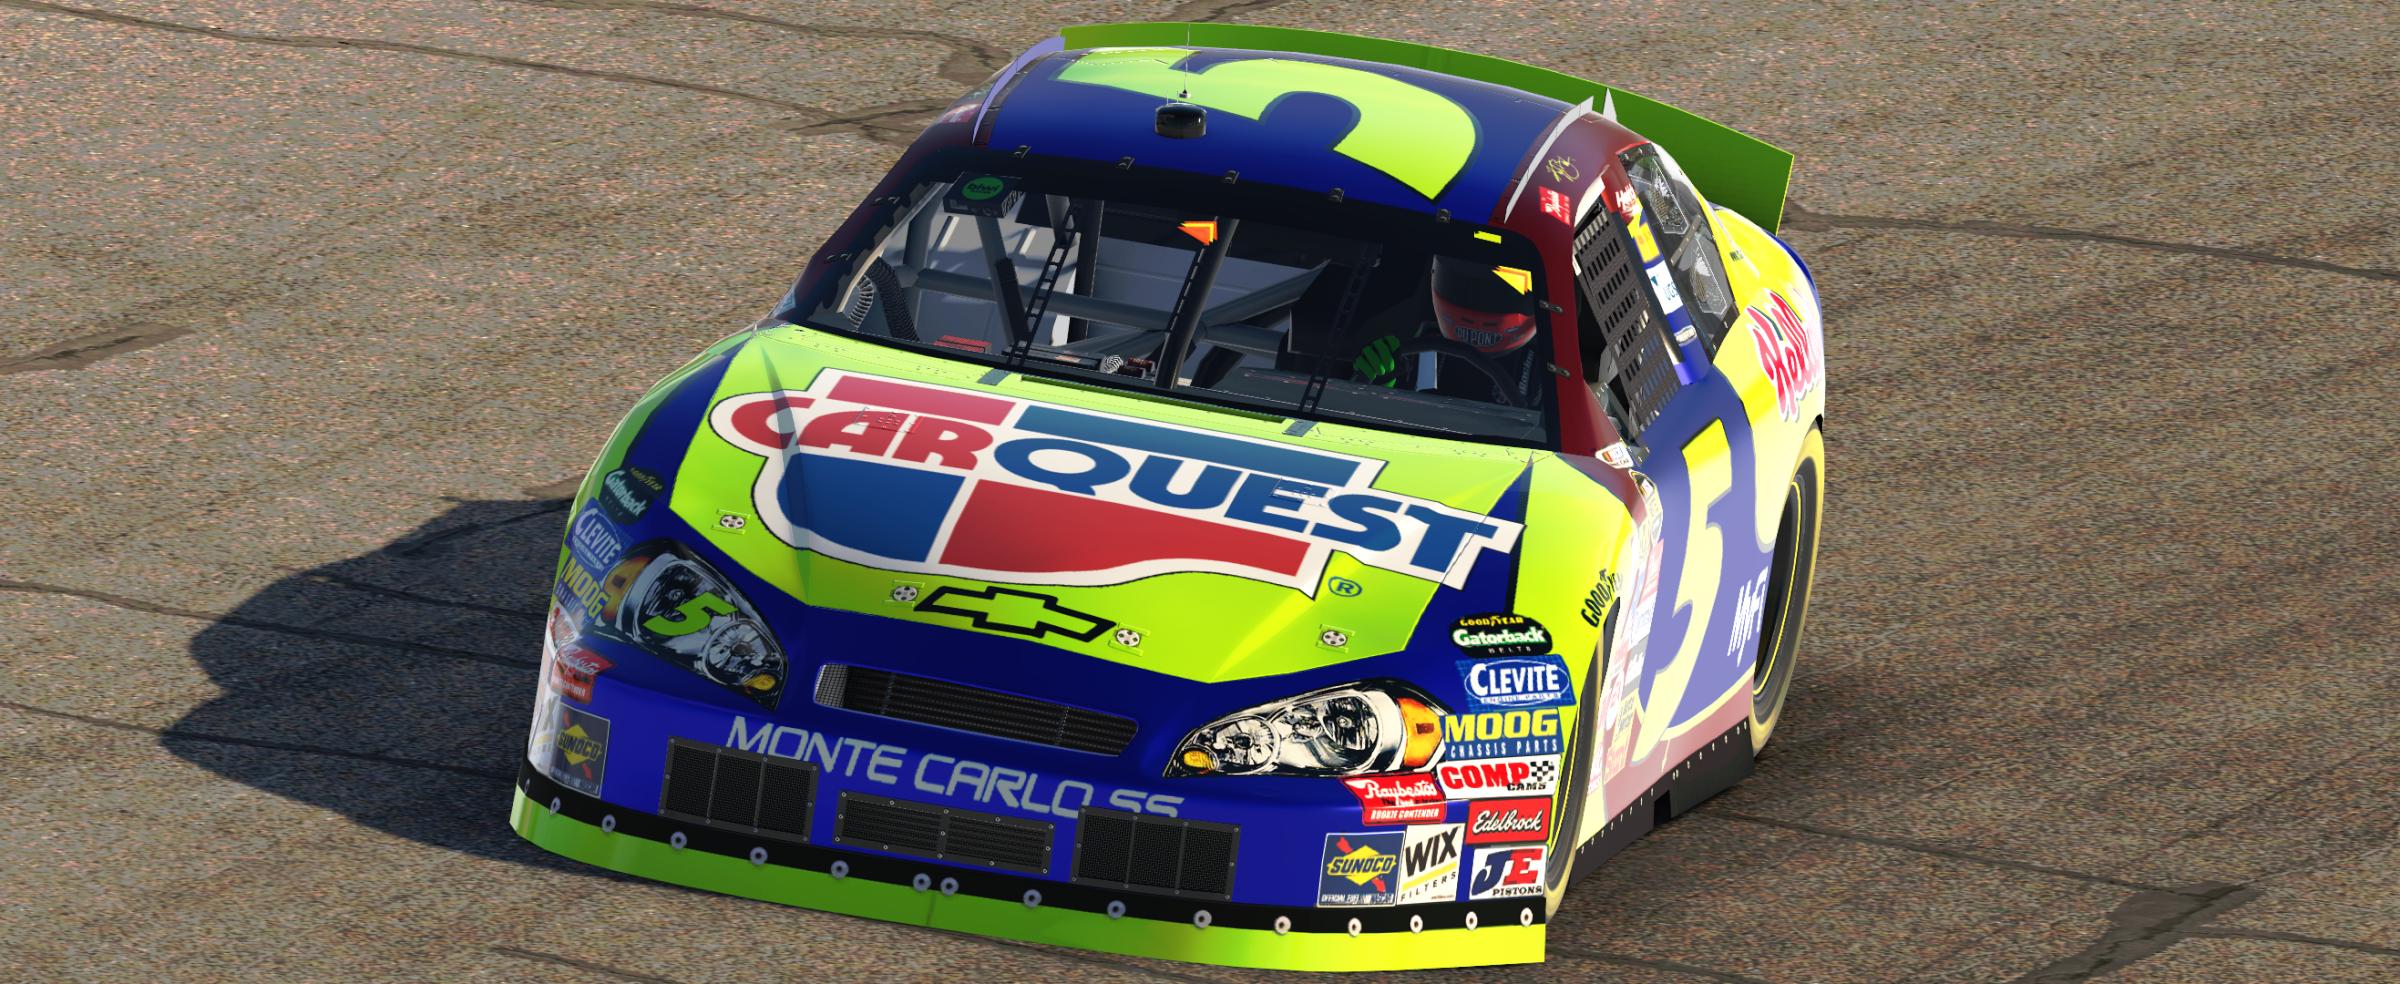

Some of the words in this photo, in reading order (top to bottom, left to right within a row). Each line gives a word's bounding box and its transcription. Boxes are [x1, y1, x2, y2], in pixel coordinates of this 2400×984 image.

[1056, 47, 1477, 201] 5
[605, 469, 648, 518] Gatorback
[731, 396, 1500, 573] CARQUEST
[575, 507, 623, 564] CLEVITE
[560, 557, 610, 619] MOOG
[1630, 418, 1733, 766] 5
[642, 591, 739, 637] 5
[1459, 614, 1524, 628] GOODYEAR
[1452, 626, 1547, 648] Gatorback
[1469, 663, 1561, 697] CLEVITE
[1444, 708, 1559, 744] MOOG
[558, 731, 601, 759] SUNOCO
[1450, 741, 1507, 759] CHASSIS
[1515, 738, 1558, 754] PARTS
[725, 715, 909, 784] MONTE
[913, 752, 1094, 819] CARLO
[1108, 788, 1185, 818] SS
[1440, 761, 1530, 790] COMP
[1506, 781, 1548, 792] CAMS
[1398, 808, 1440, 820] CONTENDER
[1472, 808, 1543, 835] Edelbrock
[1330, 857, 1396, 875] SUNOCO
[1405, 825, 1459, 878] WIX
[1400, 871, 1457, 902] FILTERS
[1471, 848, 1544, 896] JE
[1491, 885, 1543, 896] PISTONS
